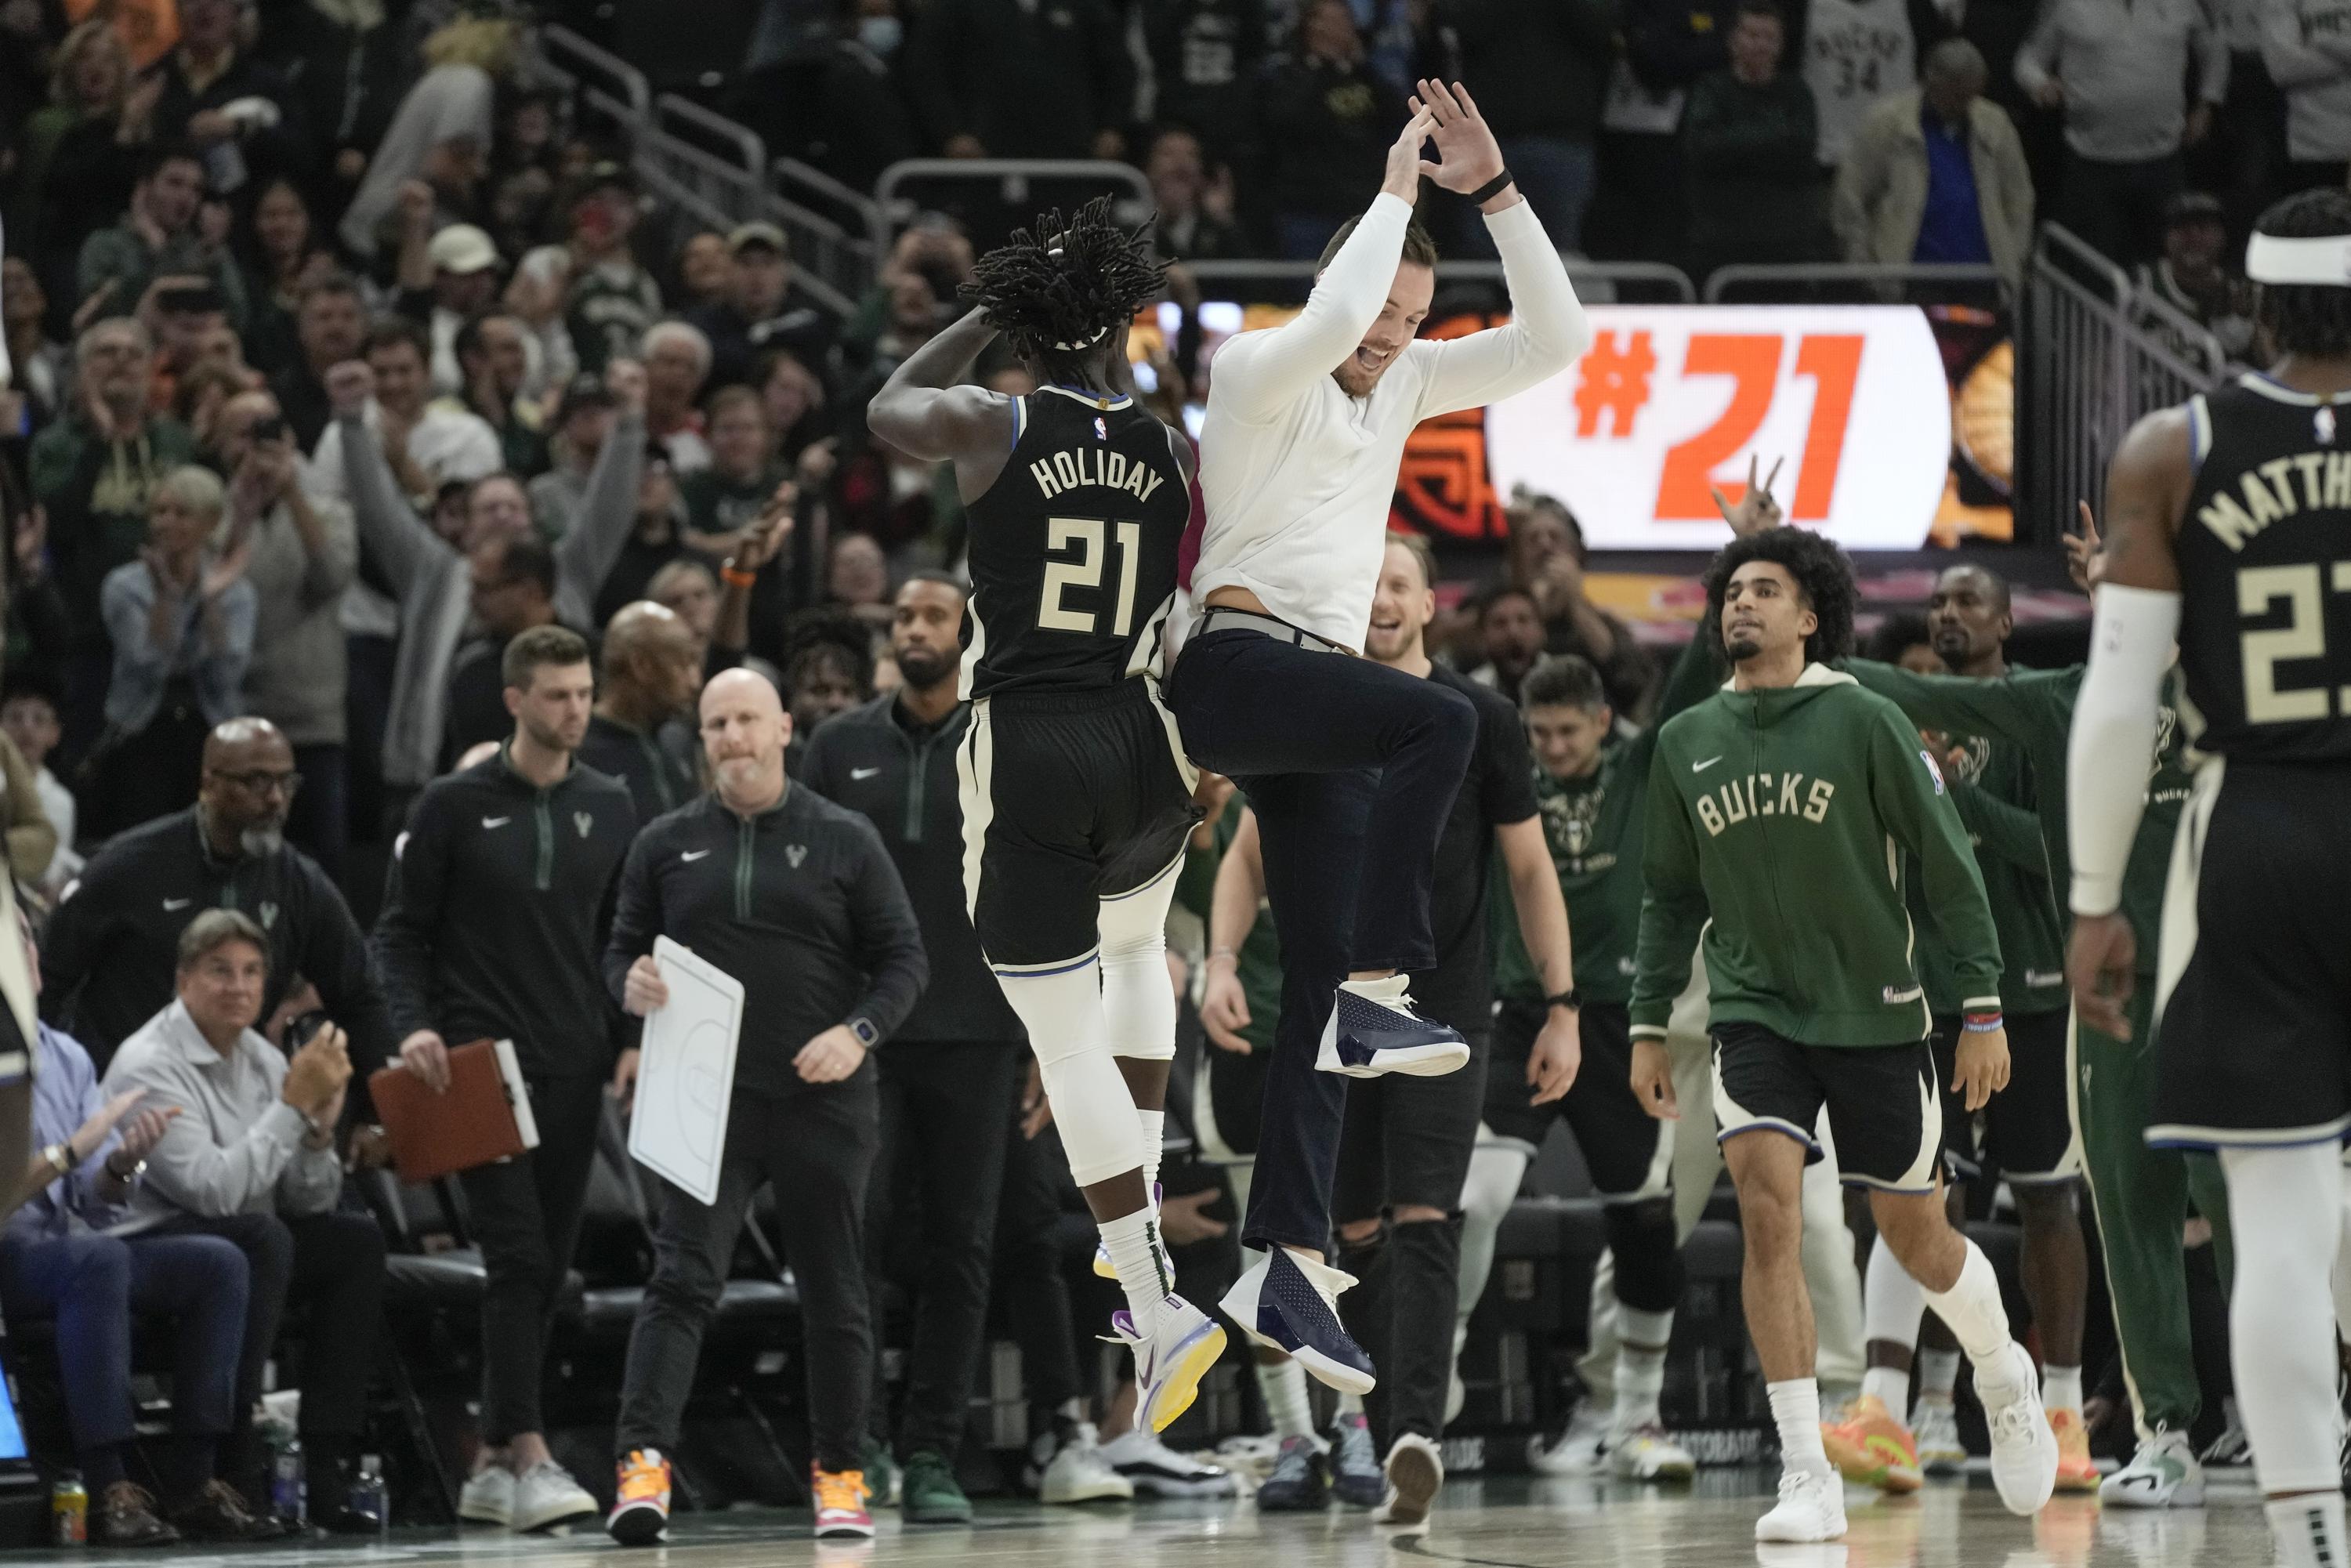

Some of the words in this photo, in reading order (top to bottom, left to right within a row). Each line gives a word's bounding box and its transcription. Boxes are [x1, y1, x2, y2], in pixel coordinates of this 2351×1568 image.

[1030, 447, 1165, 503] HOLIDAY
[1572, 330, 1866, 521] #21
[2197, 450, 2351, 553] MATTH
[1036, 516, 1143, 637] 21
[2235, 559, 2351, 726] 2
[1697, 772, 1835, 837] BUCKS
